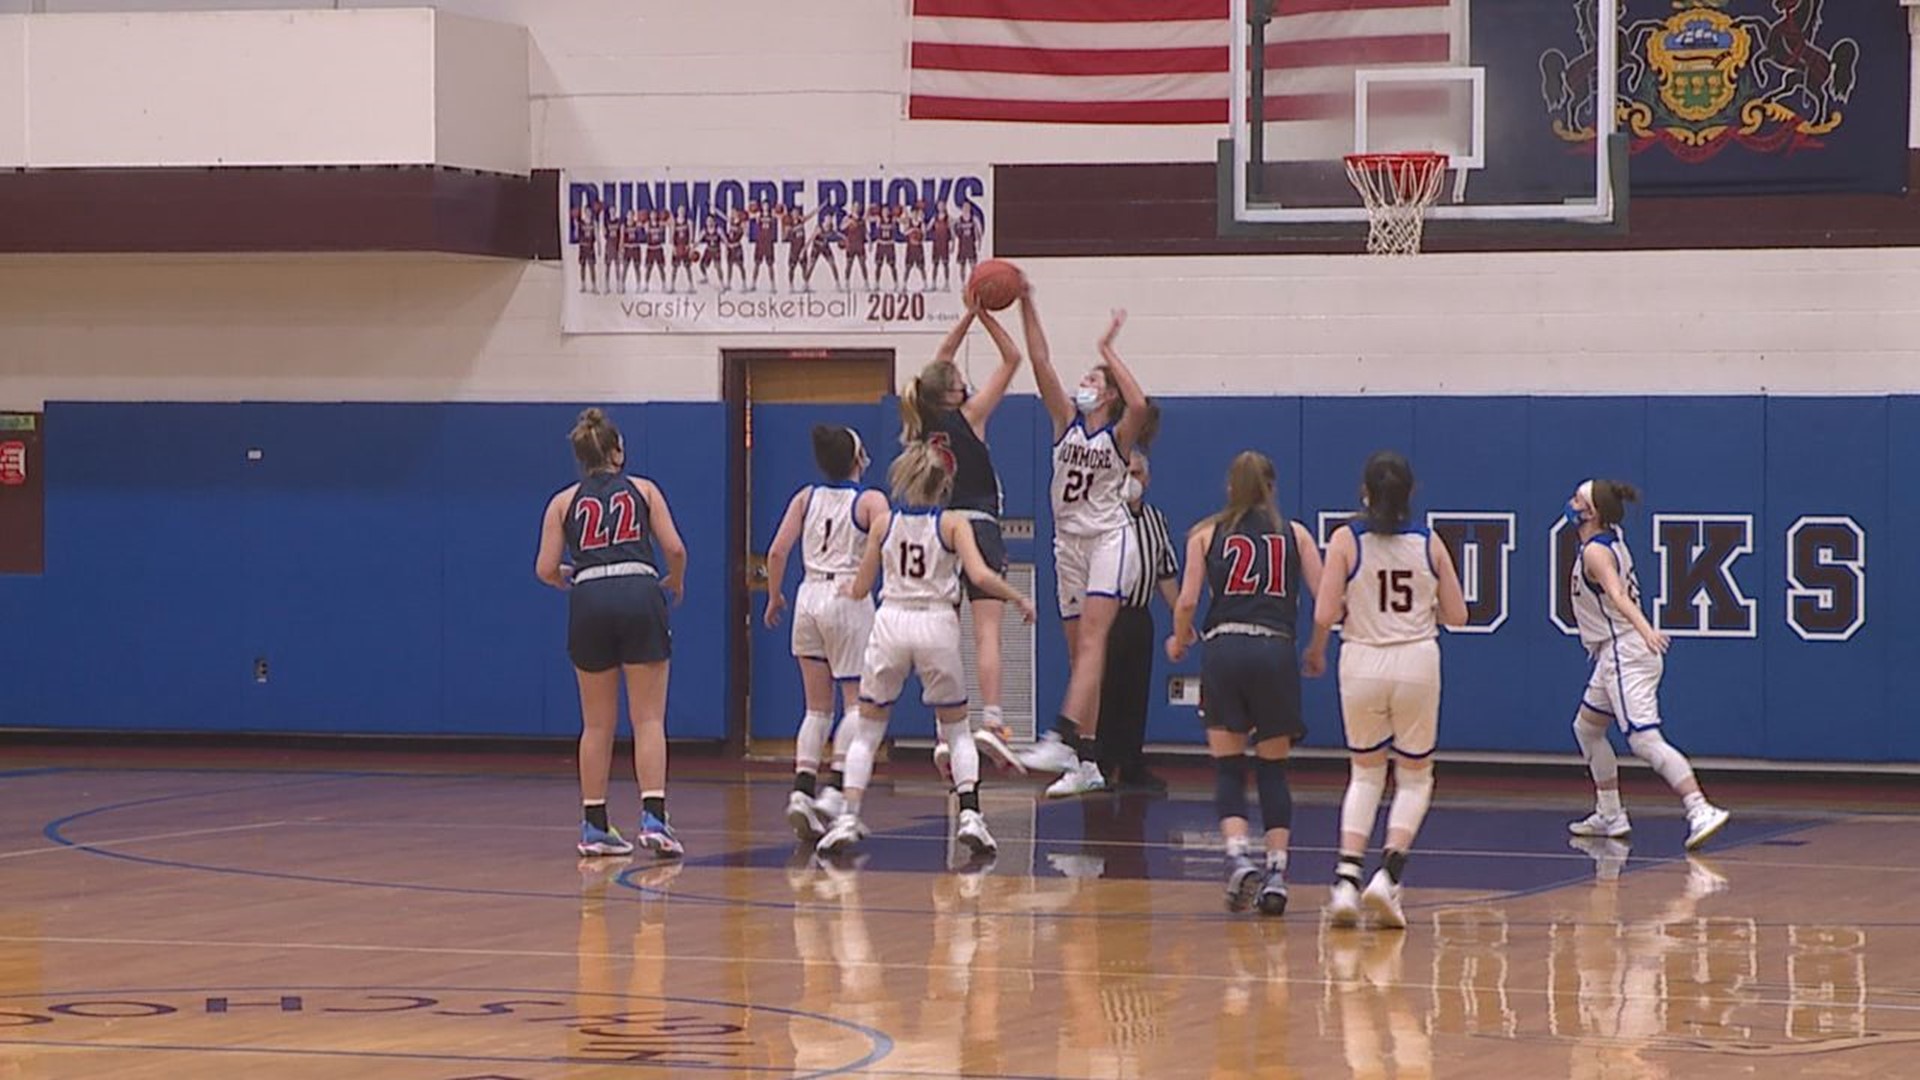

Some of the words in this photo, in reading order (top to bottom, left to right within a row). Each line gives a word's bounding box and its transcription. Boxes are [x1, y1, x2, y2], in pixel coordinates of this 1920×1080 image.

[620, 297, 706, 322] varsity
[717, 294, 858, 319] basketball
[867, 292, 926, 322] 2020
[1063, 469, 1095, 503] 21
[574, 489, 641, 551] 22
[821, 518, 832, 553] 1
[900, 540, 927, 579] 13
[1223, 533, 1287, 598] 21
[1377, 568, 1413, 613] 15
